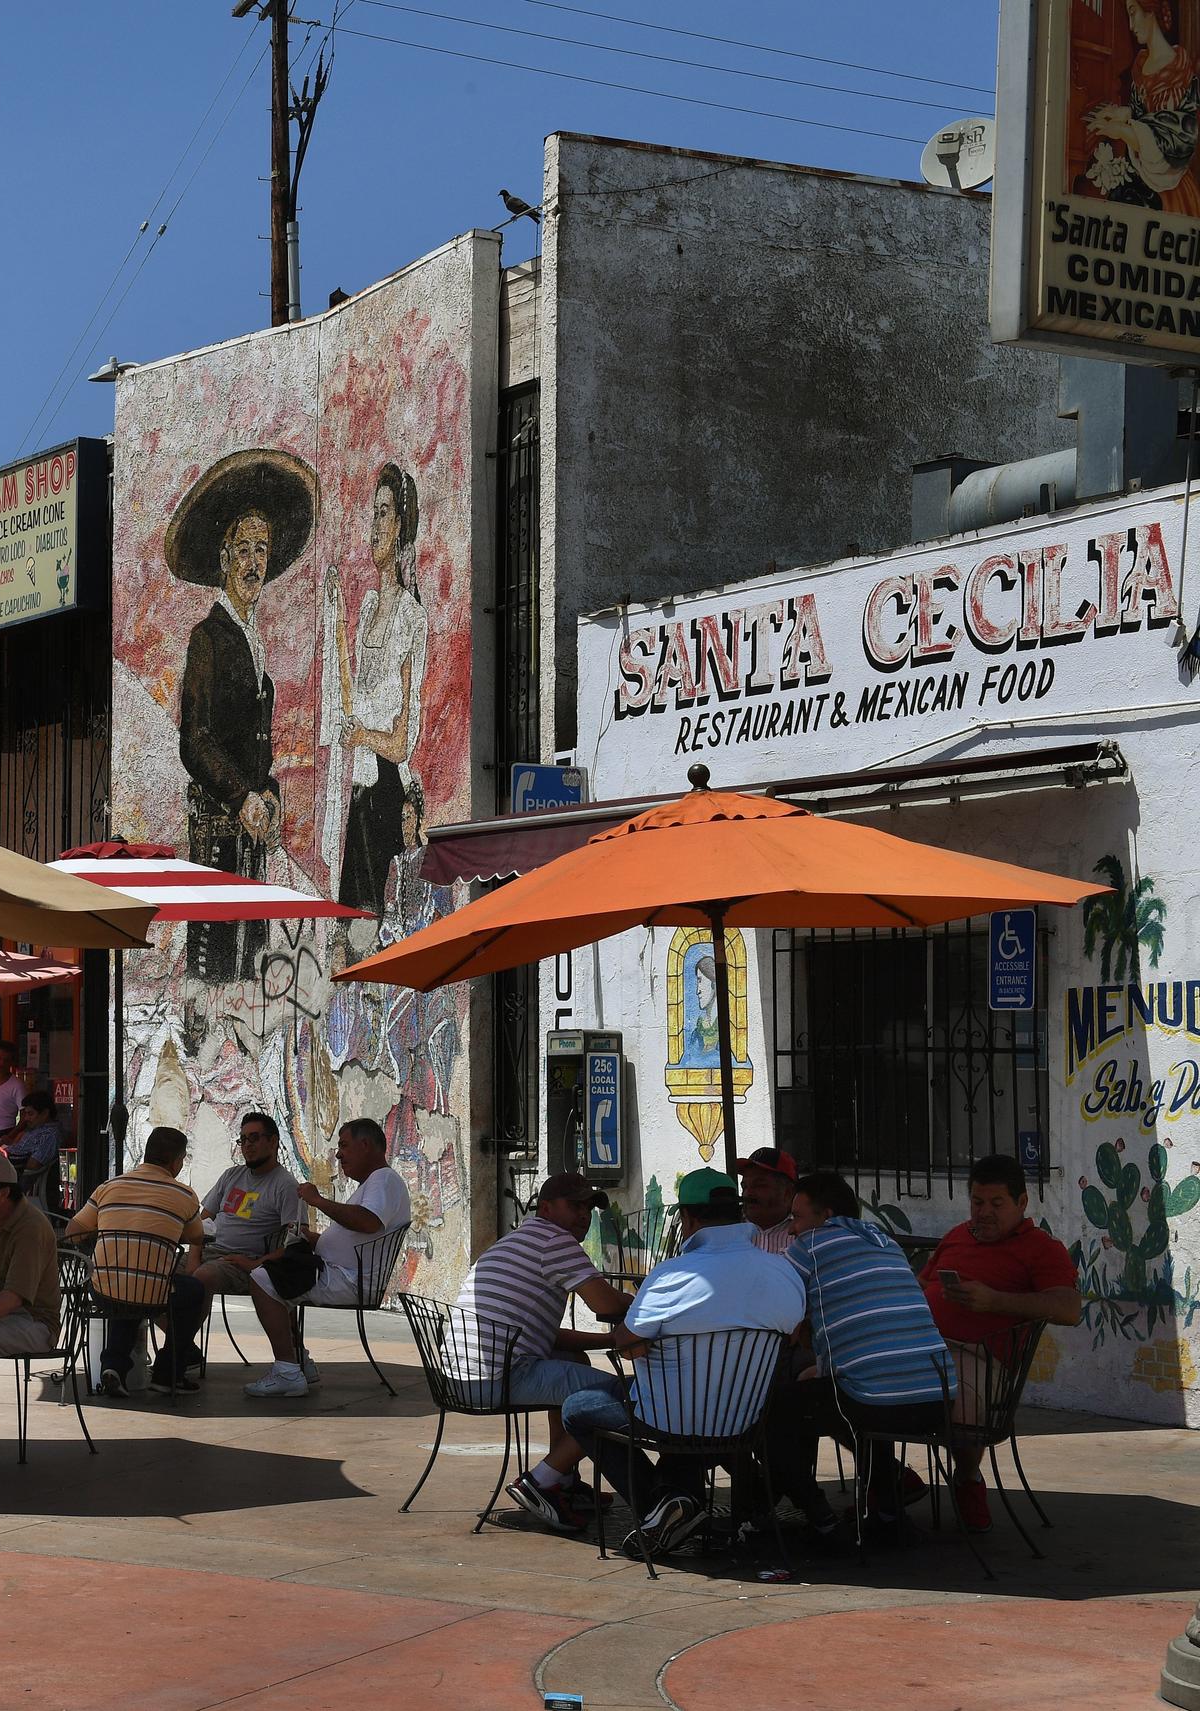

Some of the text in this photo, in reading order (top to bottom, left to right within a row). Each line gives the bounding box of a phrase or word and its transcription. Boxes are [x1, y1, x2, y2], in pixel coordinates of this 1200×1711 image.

[1047, 286, 1200, 337] MEXICAN
[24, 450, 76, 505] SHOP
[10, 508, 41, 536] CREAM
[42, 501, 66, 526] CONE
[10, 539, 26, 560] LOCO
[35, 526, 68, 554] DIABLITOS
[4, 591, 42, 616] CAPUCHINO
[615, 522, 1179, 720] SANTA CECILIA
[674, 657, 1055, 755] RESTAURANT & MEXICAN FOOD
[995, 961, 1030, 971] ACCESSIBLE
[996, 976, 1027, 985] ENTRANCE
[559, 1039, 576, 1049] Phone
[591, 1076, 615, 1084] LOCAL
[591, 1086, 615, 1095] CALLS
